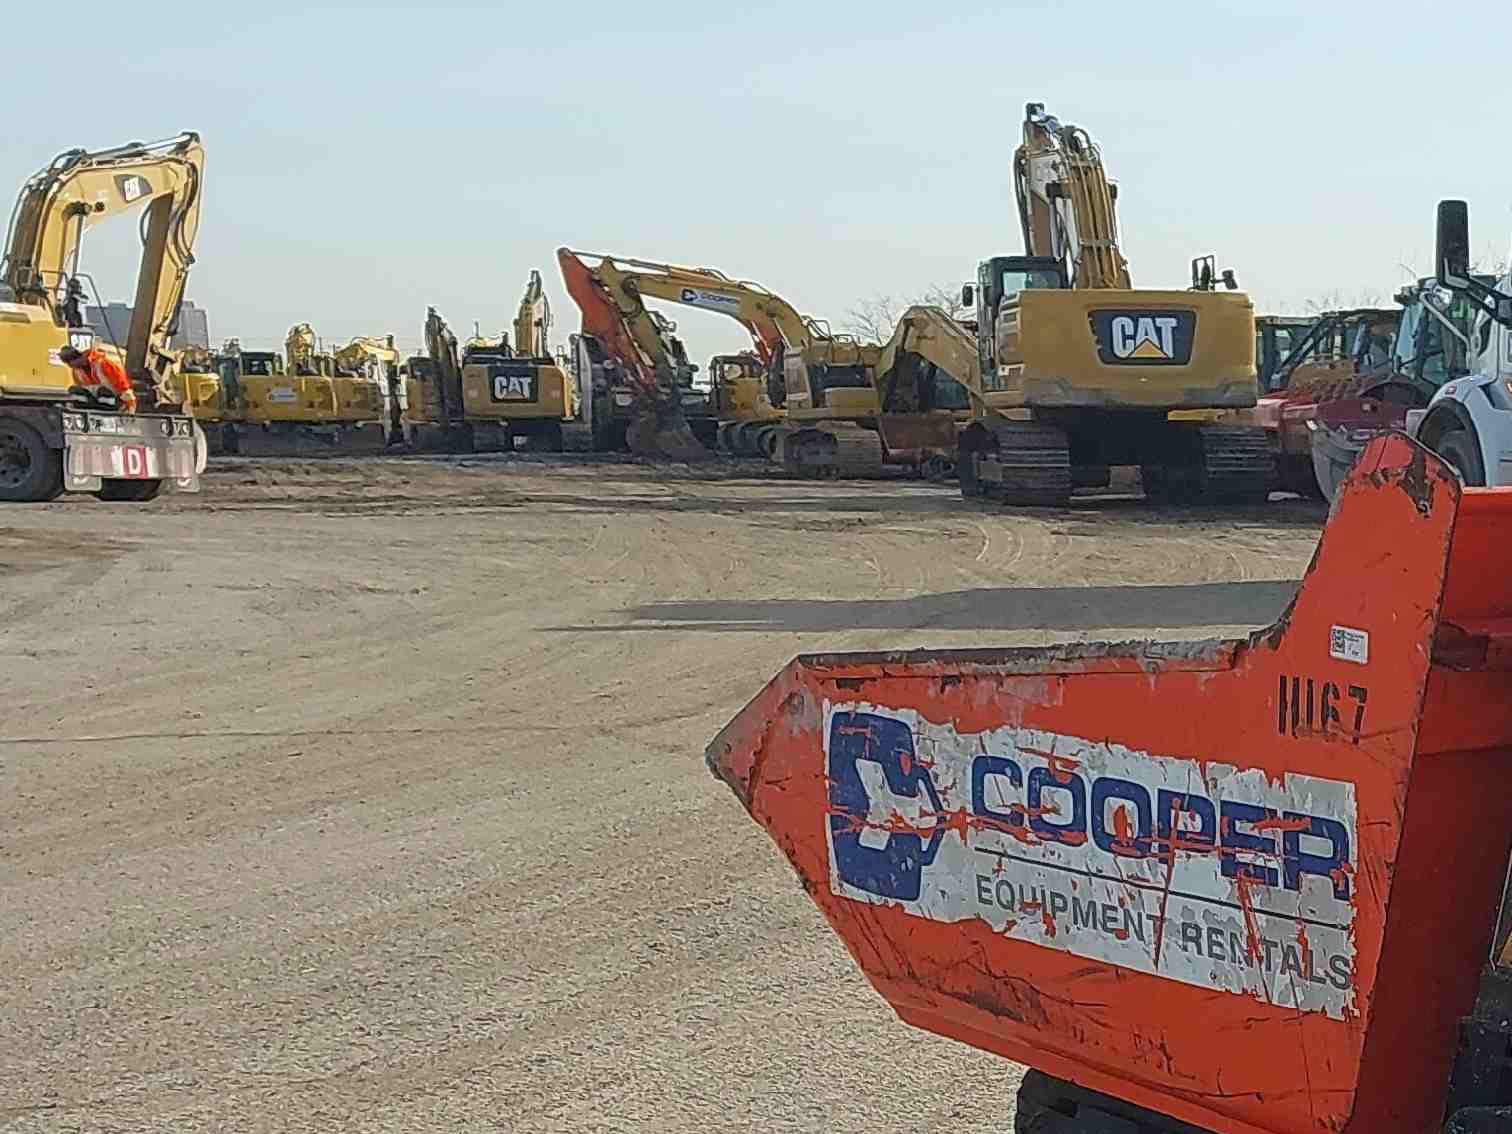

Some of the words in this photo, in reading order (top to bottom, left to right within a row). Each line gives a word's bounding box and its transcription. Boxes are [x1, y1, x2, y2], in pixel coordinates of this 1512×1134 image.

[1111, 316, 1178, 359] CAT
[494, 375, 531, 399] CAT
[971, 754, 1350, 901] COOPER
[975, 873, 1166, 944] EQUIPMENT
[1181, 920, 1350, 992] RENTALS
